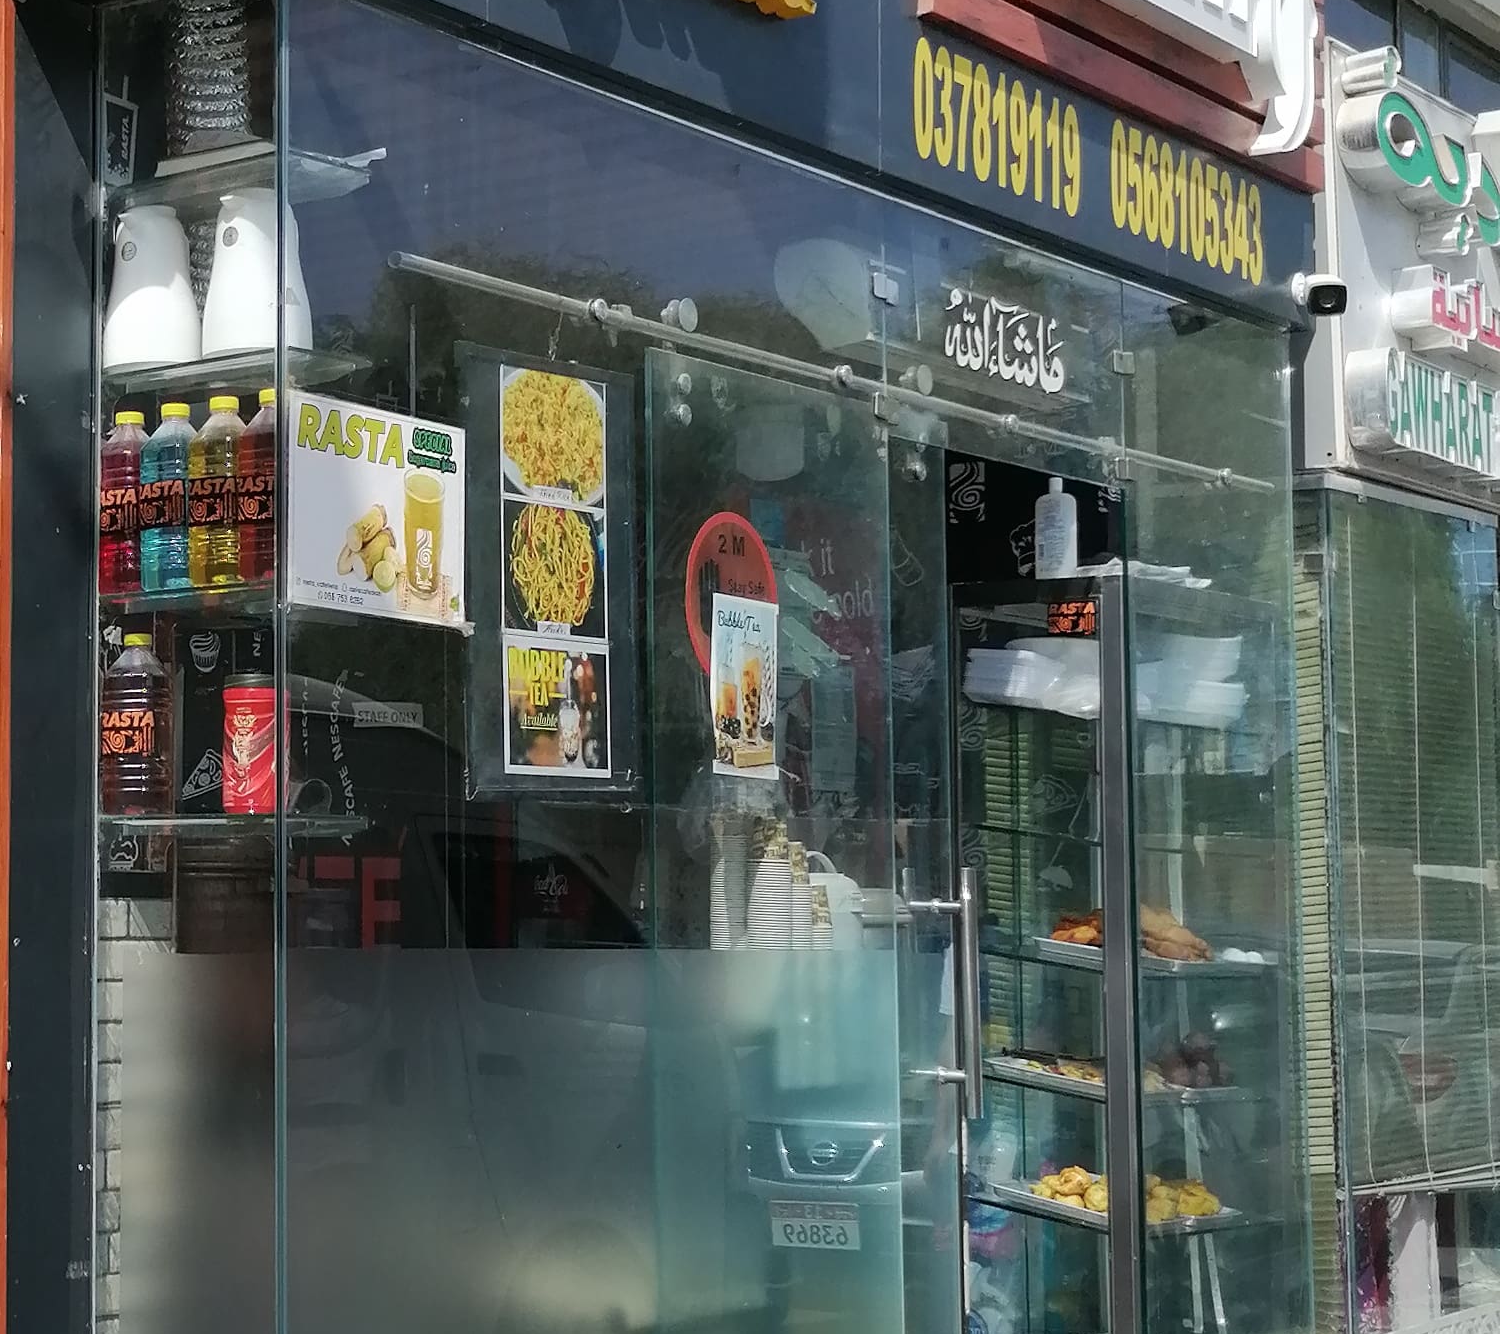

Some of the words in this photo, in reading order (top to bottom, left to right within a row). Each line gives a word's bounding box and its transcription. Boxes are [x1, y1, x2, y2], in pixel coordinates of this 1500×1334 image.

[913, 36, 1081, 218] 037819119
[1110, 118, 1264, 286] 0568105343
[1378, 347, 1498, 478] GAWHARAT
[297, 403, 406, 469] RASTA
[412, 428, 453, 456] SPECIAL
[717, 533, 728, 554] 2
[732, 534, 746, 557] M
[508, 646, 567, 682] BUBBLE
[530, 681, 549, 707] TEA
